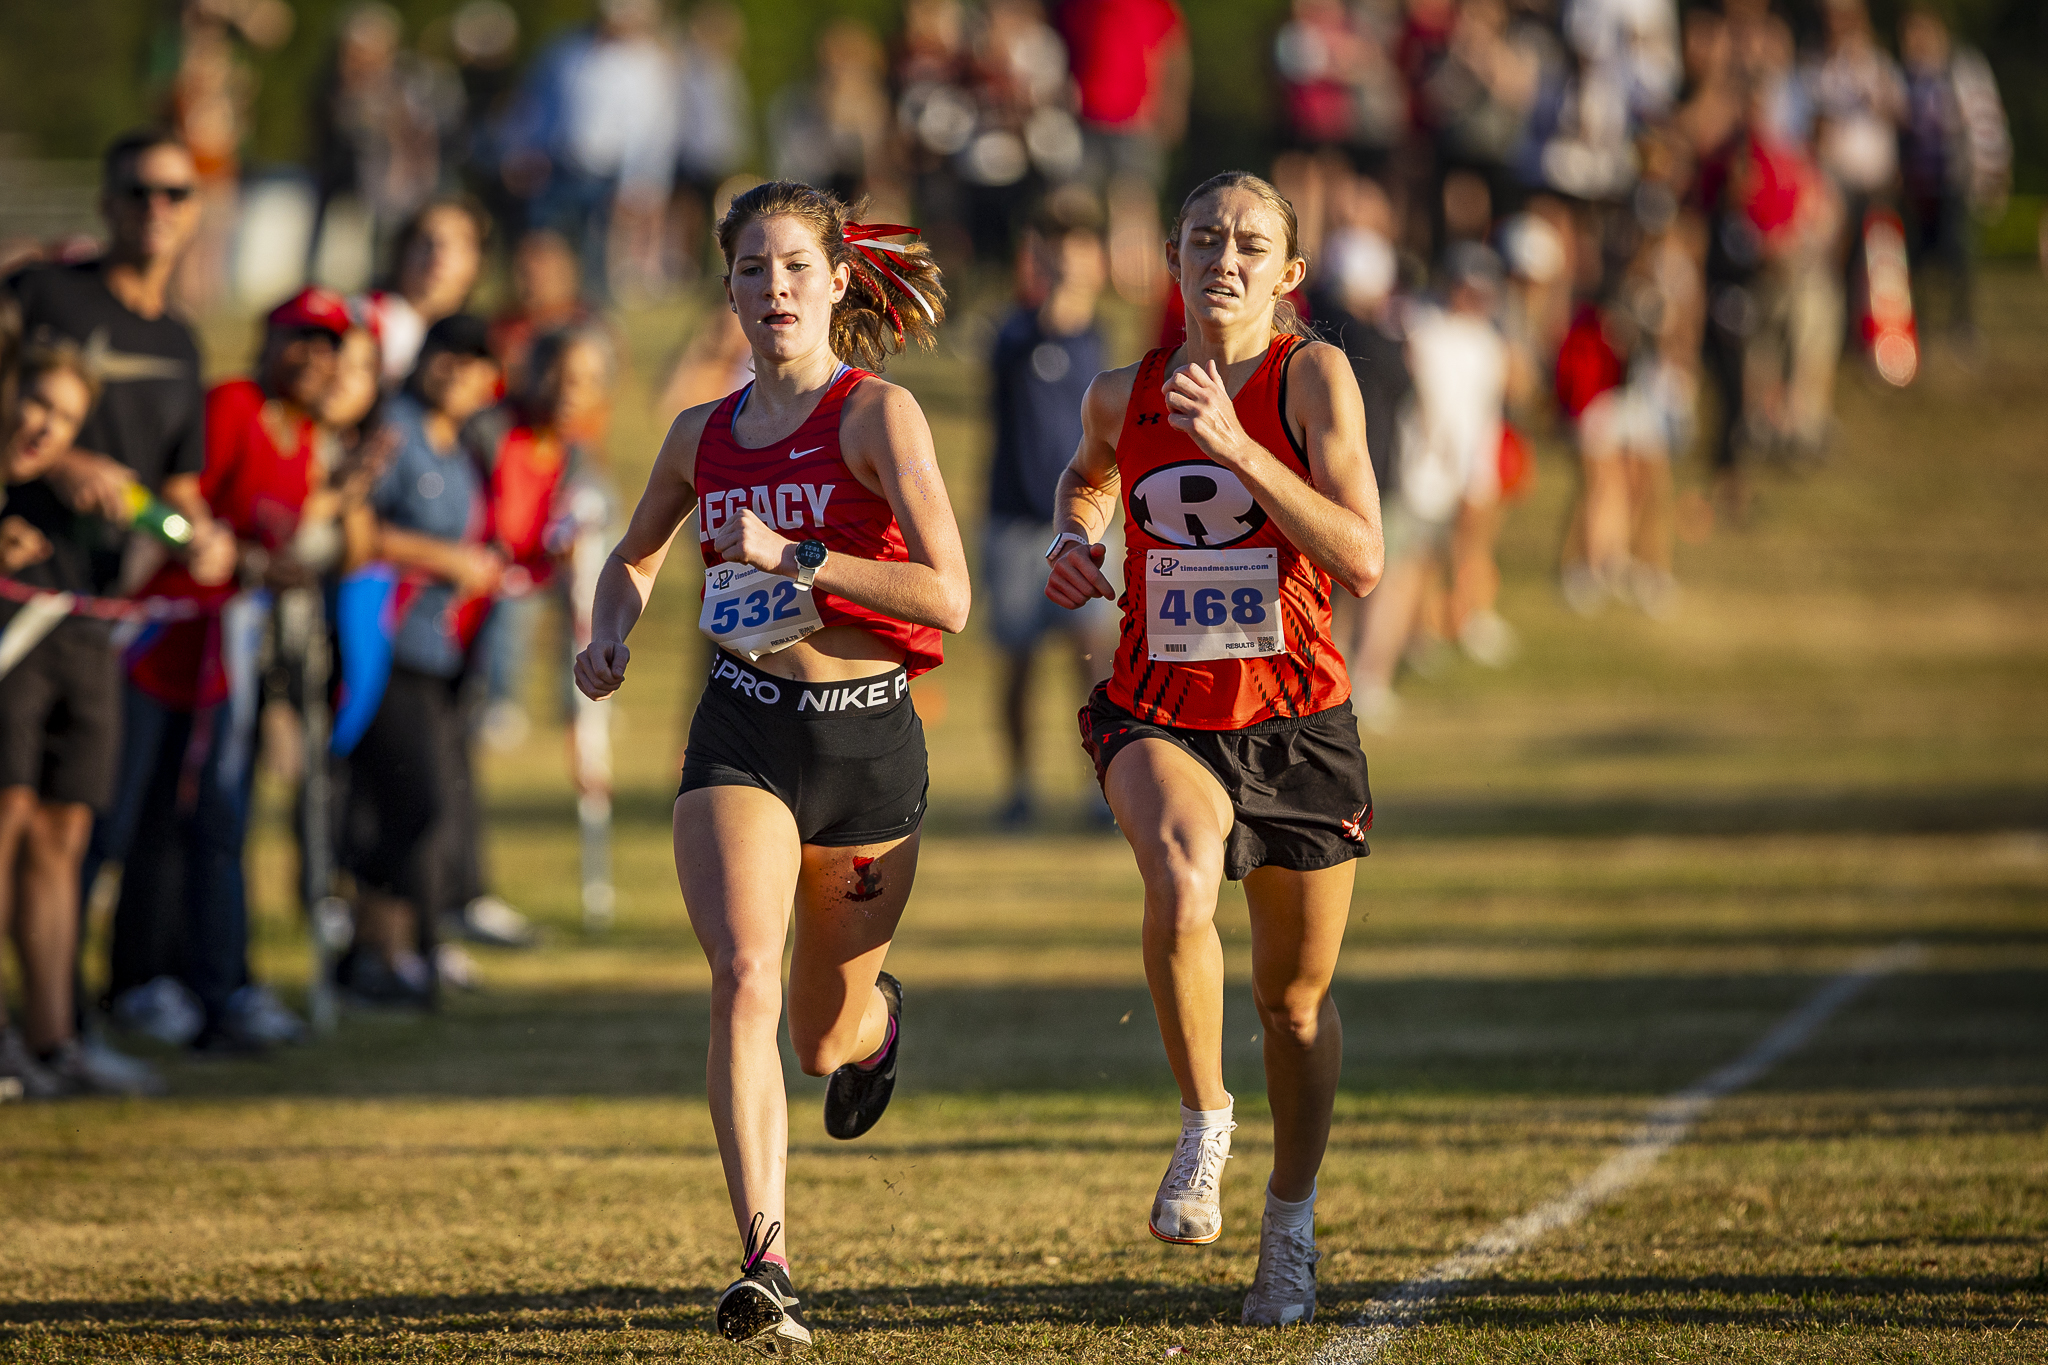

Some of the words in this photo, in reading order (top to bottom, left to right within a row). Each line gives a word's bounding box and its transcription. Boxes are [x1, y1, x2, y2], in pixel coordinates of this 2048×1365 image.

[697, 483, 836, 543] LEGACY
[1133, 464, 1255, 547] R
[1180, 563, 1269, 572] timeandmeasure.com
[710, 580, 801, 635] 532
[1159, 587, 1266, 627] 468
[770, 634, 799, 646] RESULTS
[1225, 641, 1255, 650] RESULTS
[714, 659, 781, 705] PRO
[797, 680, 889, 712] NIKE
